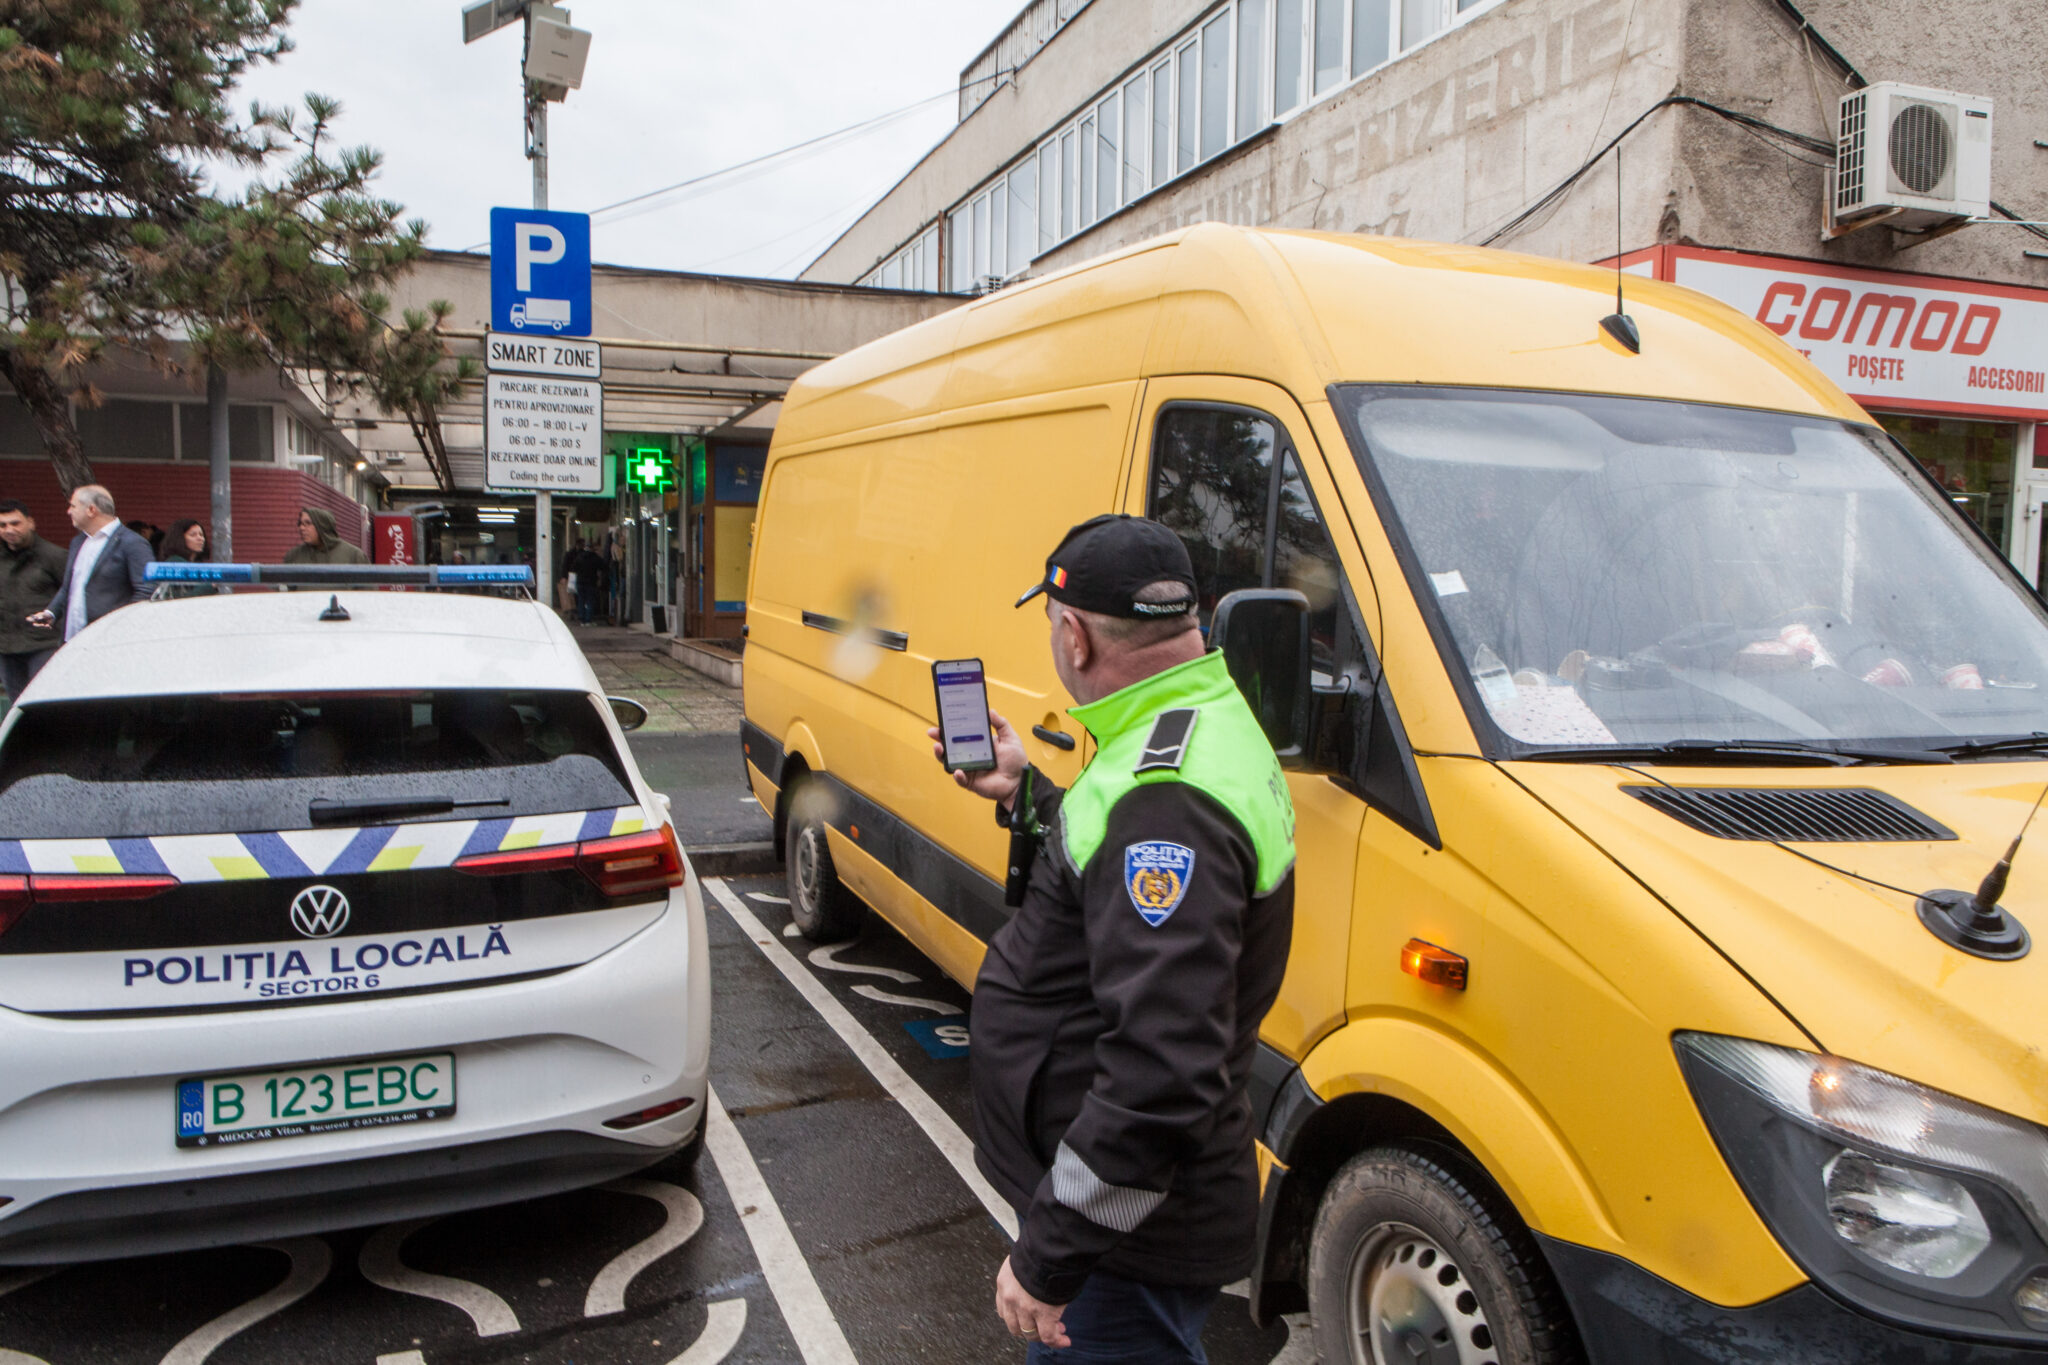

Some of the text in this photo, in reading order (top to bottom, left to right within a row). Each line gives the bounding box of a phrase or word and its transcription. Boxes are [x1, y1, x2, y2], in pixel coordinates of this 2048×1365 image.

[515, 222, 566, 292] P
[1756, 281, 2001, 356] COMOD
[492, 342, 595, 368] SMART ZONE
[1848, 354, 1904, 385] POȘETE
[1967, 365, 2045, 393] ACCESORII
[500, 381, 538, 395] PARCARE
[493, 398, 595, 416] PENTRU APROVIZIONARE
[502, 417, 529, 429] 06:00
[509, 435, 536, 447] 06:00
[575, 440, 581, 449] S
[491, 451, 598, 468] REZERVARE DOAR ONLINE
[510, 470, 580, 484] Coding the curbs
[124, 924, 511, 990] POLIȚIA LOCALĂ
[259, 974, 380, 997] SECTOR 6
[213, 1062, 439, 1125] B 123 EBC
[183, 1111, 203, 1129] RO
